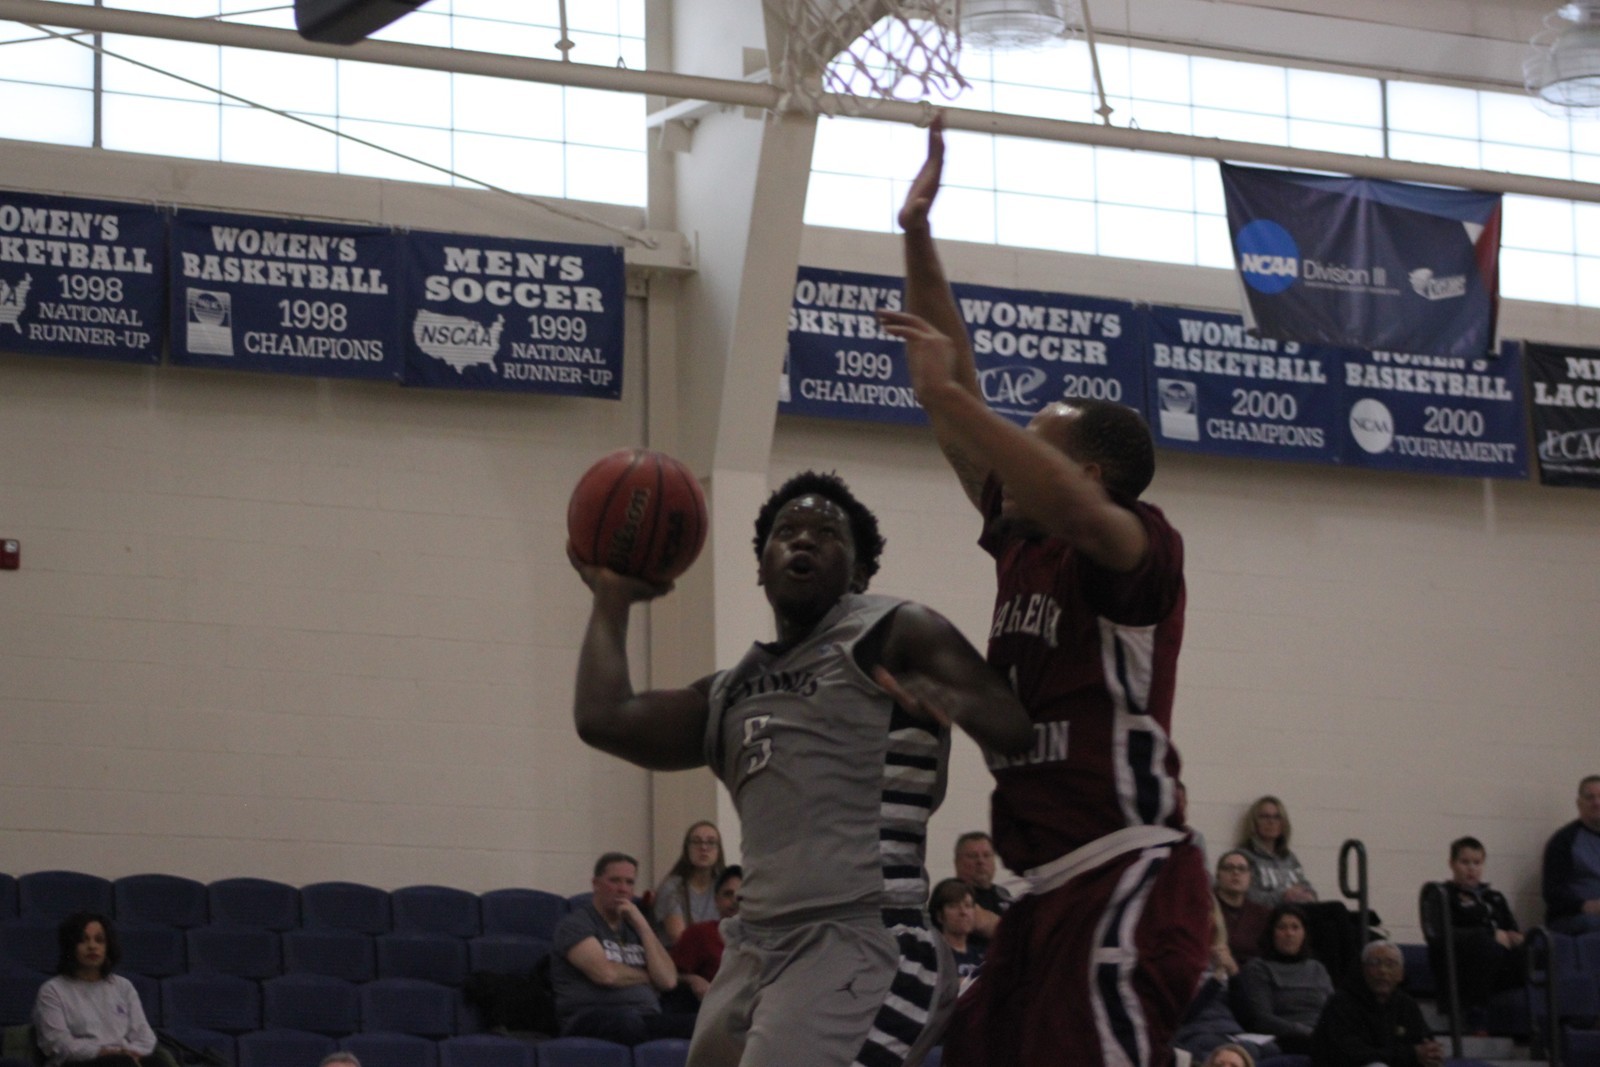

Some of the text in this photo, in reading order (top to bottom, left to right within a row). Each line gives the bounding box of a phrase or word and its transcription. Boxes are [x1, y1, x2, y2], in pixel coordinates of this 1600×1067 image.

[0, 205, 119, 241] OMEN'S
[0, 236, 153, 274] KETBALL
[211, 225, 357, 263] WOMEN'S
[181, 252, 388, 295] BASKETBALL
[444, 247, 584, 281] MEN'S
[1241, 252, 1298, 278] NCAA
[1303, 258, 1369, 285] Division
[58, 274, 123, 302] 1998
[425, 275, 604, 312] SOCCER
[39, 302, 143, 327] NATIONAL
[278, 299, 347, 332] 1998
[528, 315, 587, 342] 1999
[960, 298, 1122, 338] WOMEN'S
[29, 325, 150, 349] RUNNER-UP
[244, 331, 384, 362] CHAMPIONS
[420, 325, 493, 347] NSCAA
[974, 329, 1108, 365] SOCCER
[511, 342, 606, 364] NATIONAL
[835, 350, 893, 380] 1999
[1154, 343, 1326, 384] BASKETBALL
[503, 363, 612, 386] RUNNER-UP
[1063, 374, 1122, 401] 2000
[1344, 362, 1512, 401] BASKETBALL
[1231, 388, 1297, 420] 2000
[1534, 381, 1600, 409] LAC
[1206, 418, 1325, 448] CHAMPIONS
[1423, 406, 1484, 437] 2000
[1397, 436, 1516, 463] TOURNAMENT
[743, 714, 773, 775] 5
